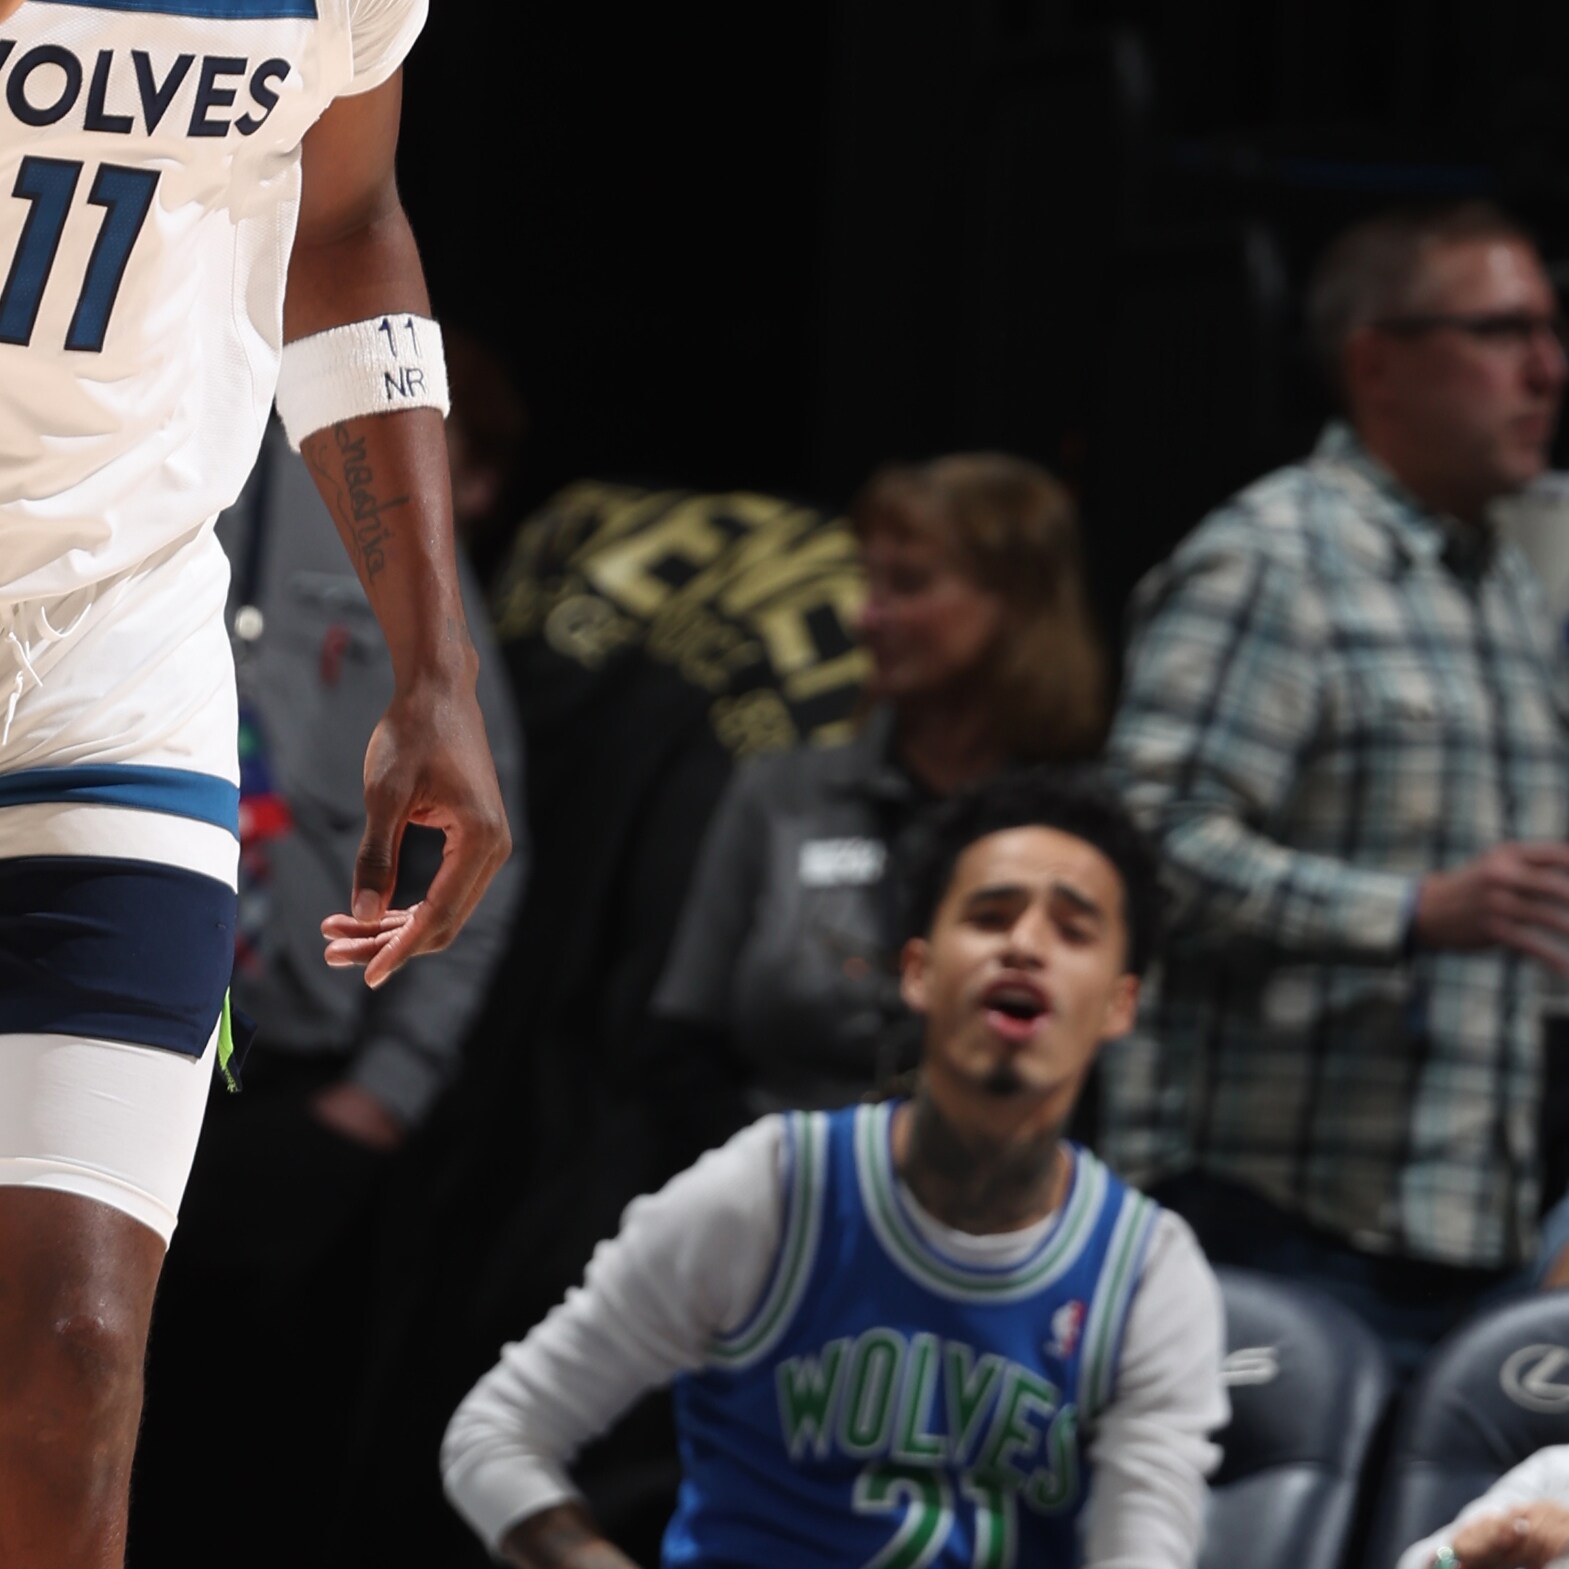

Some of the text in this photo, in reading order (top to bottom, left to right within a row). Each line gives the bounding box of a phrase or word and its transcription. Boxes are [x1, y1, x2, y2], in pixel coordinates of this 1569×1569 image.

[378, 317, 420, 360] 11
[384, 366, 426, 401] NR
[774, 1326, 1078, 1508] WOLVES
